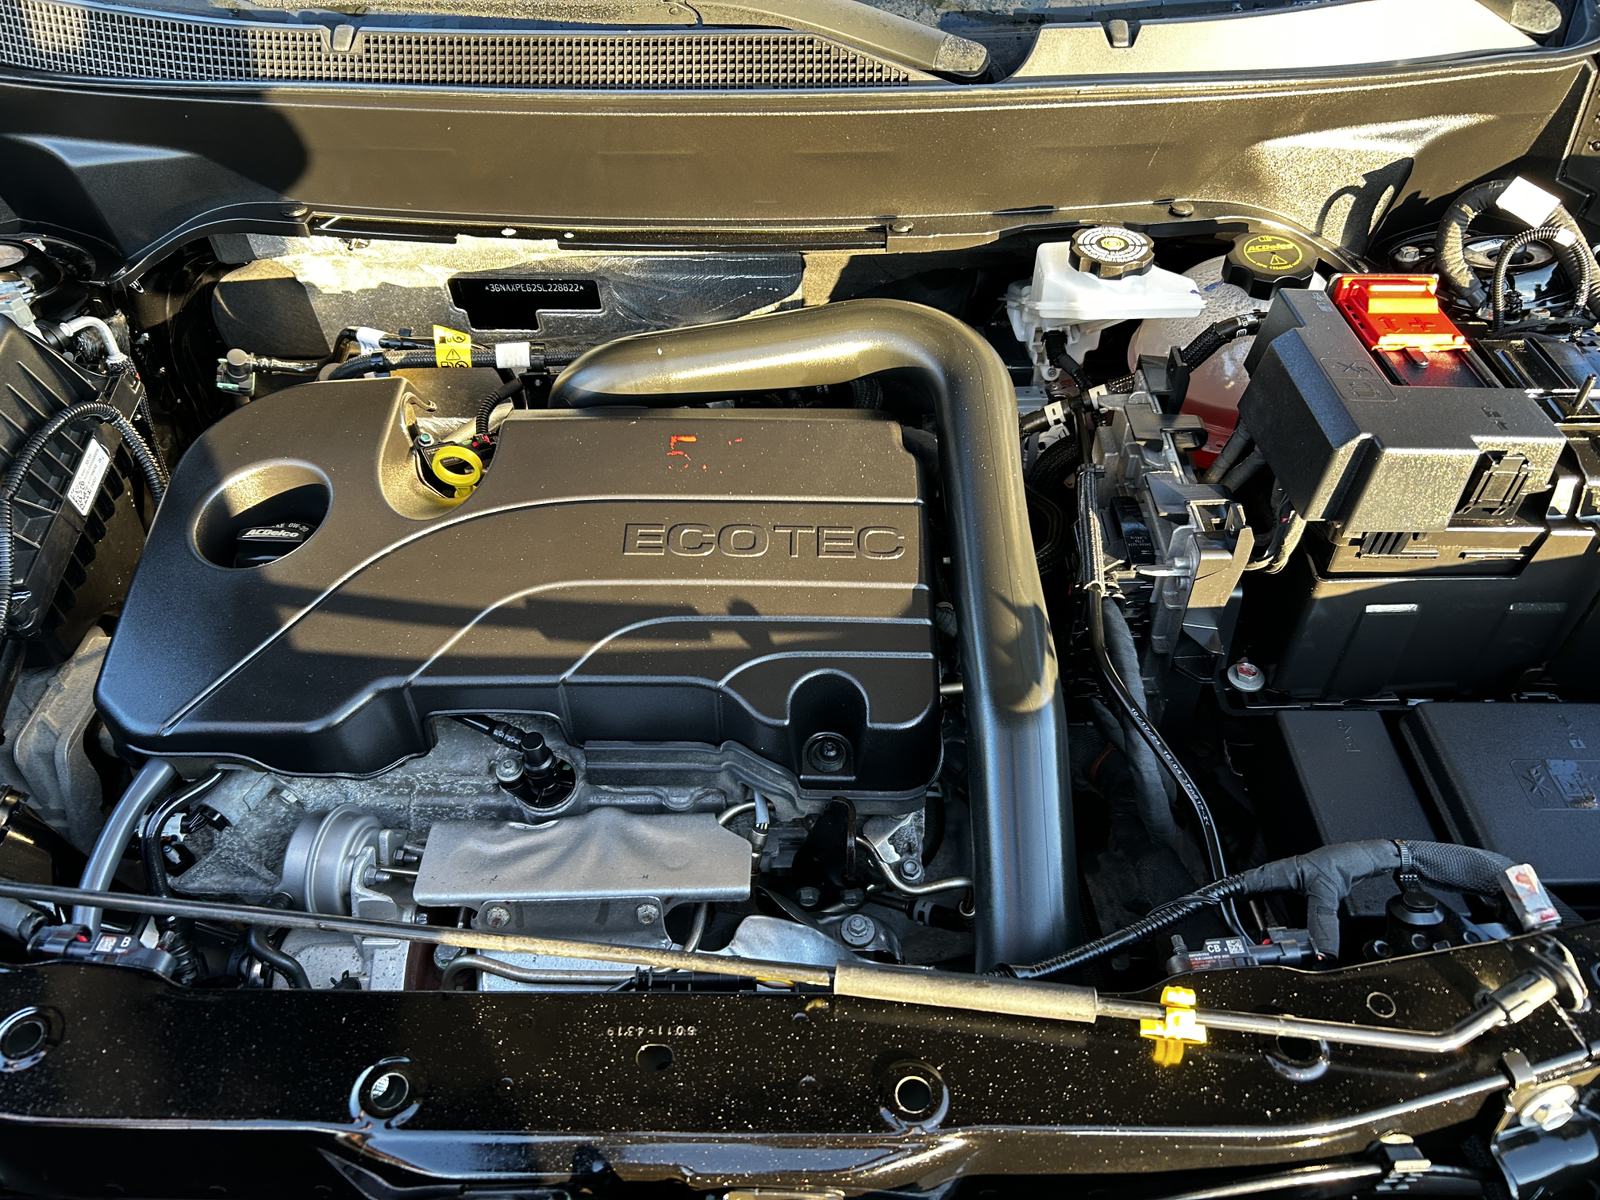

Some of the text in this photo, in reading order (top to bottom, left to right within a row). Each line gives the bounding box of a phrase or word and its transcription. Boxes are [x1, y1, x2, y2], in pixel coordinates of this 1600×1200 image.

[287, 522, 310, 533] 0W-20
[243, 529, 299, 538] ACDelco
[622, 523, 906, 560] ECOTEC
[1163, 750, 1182, 775] 16:04
[121, 936, 132, 947] B
[1207, 944, 1221, 953] CB
